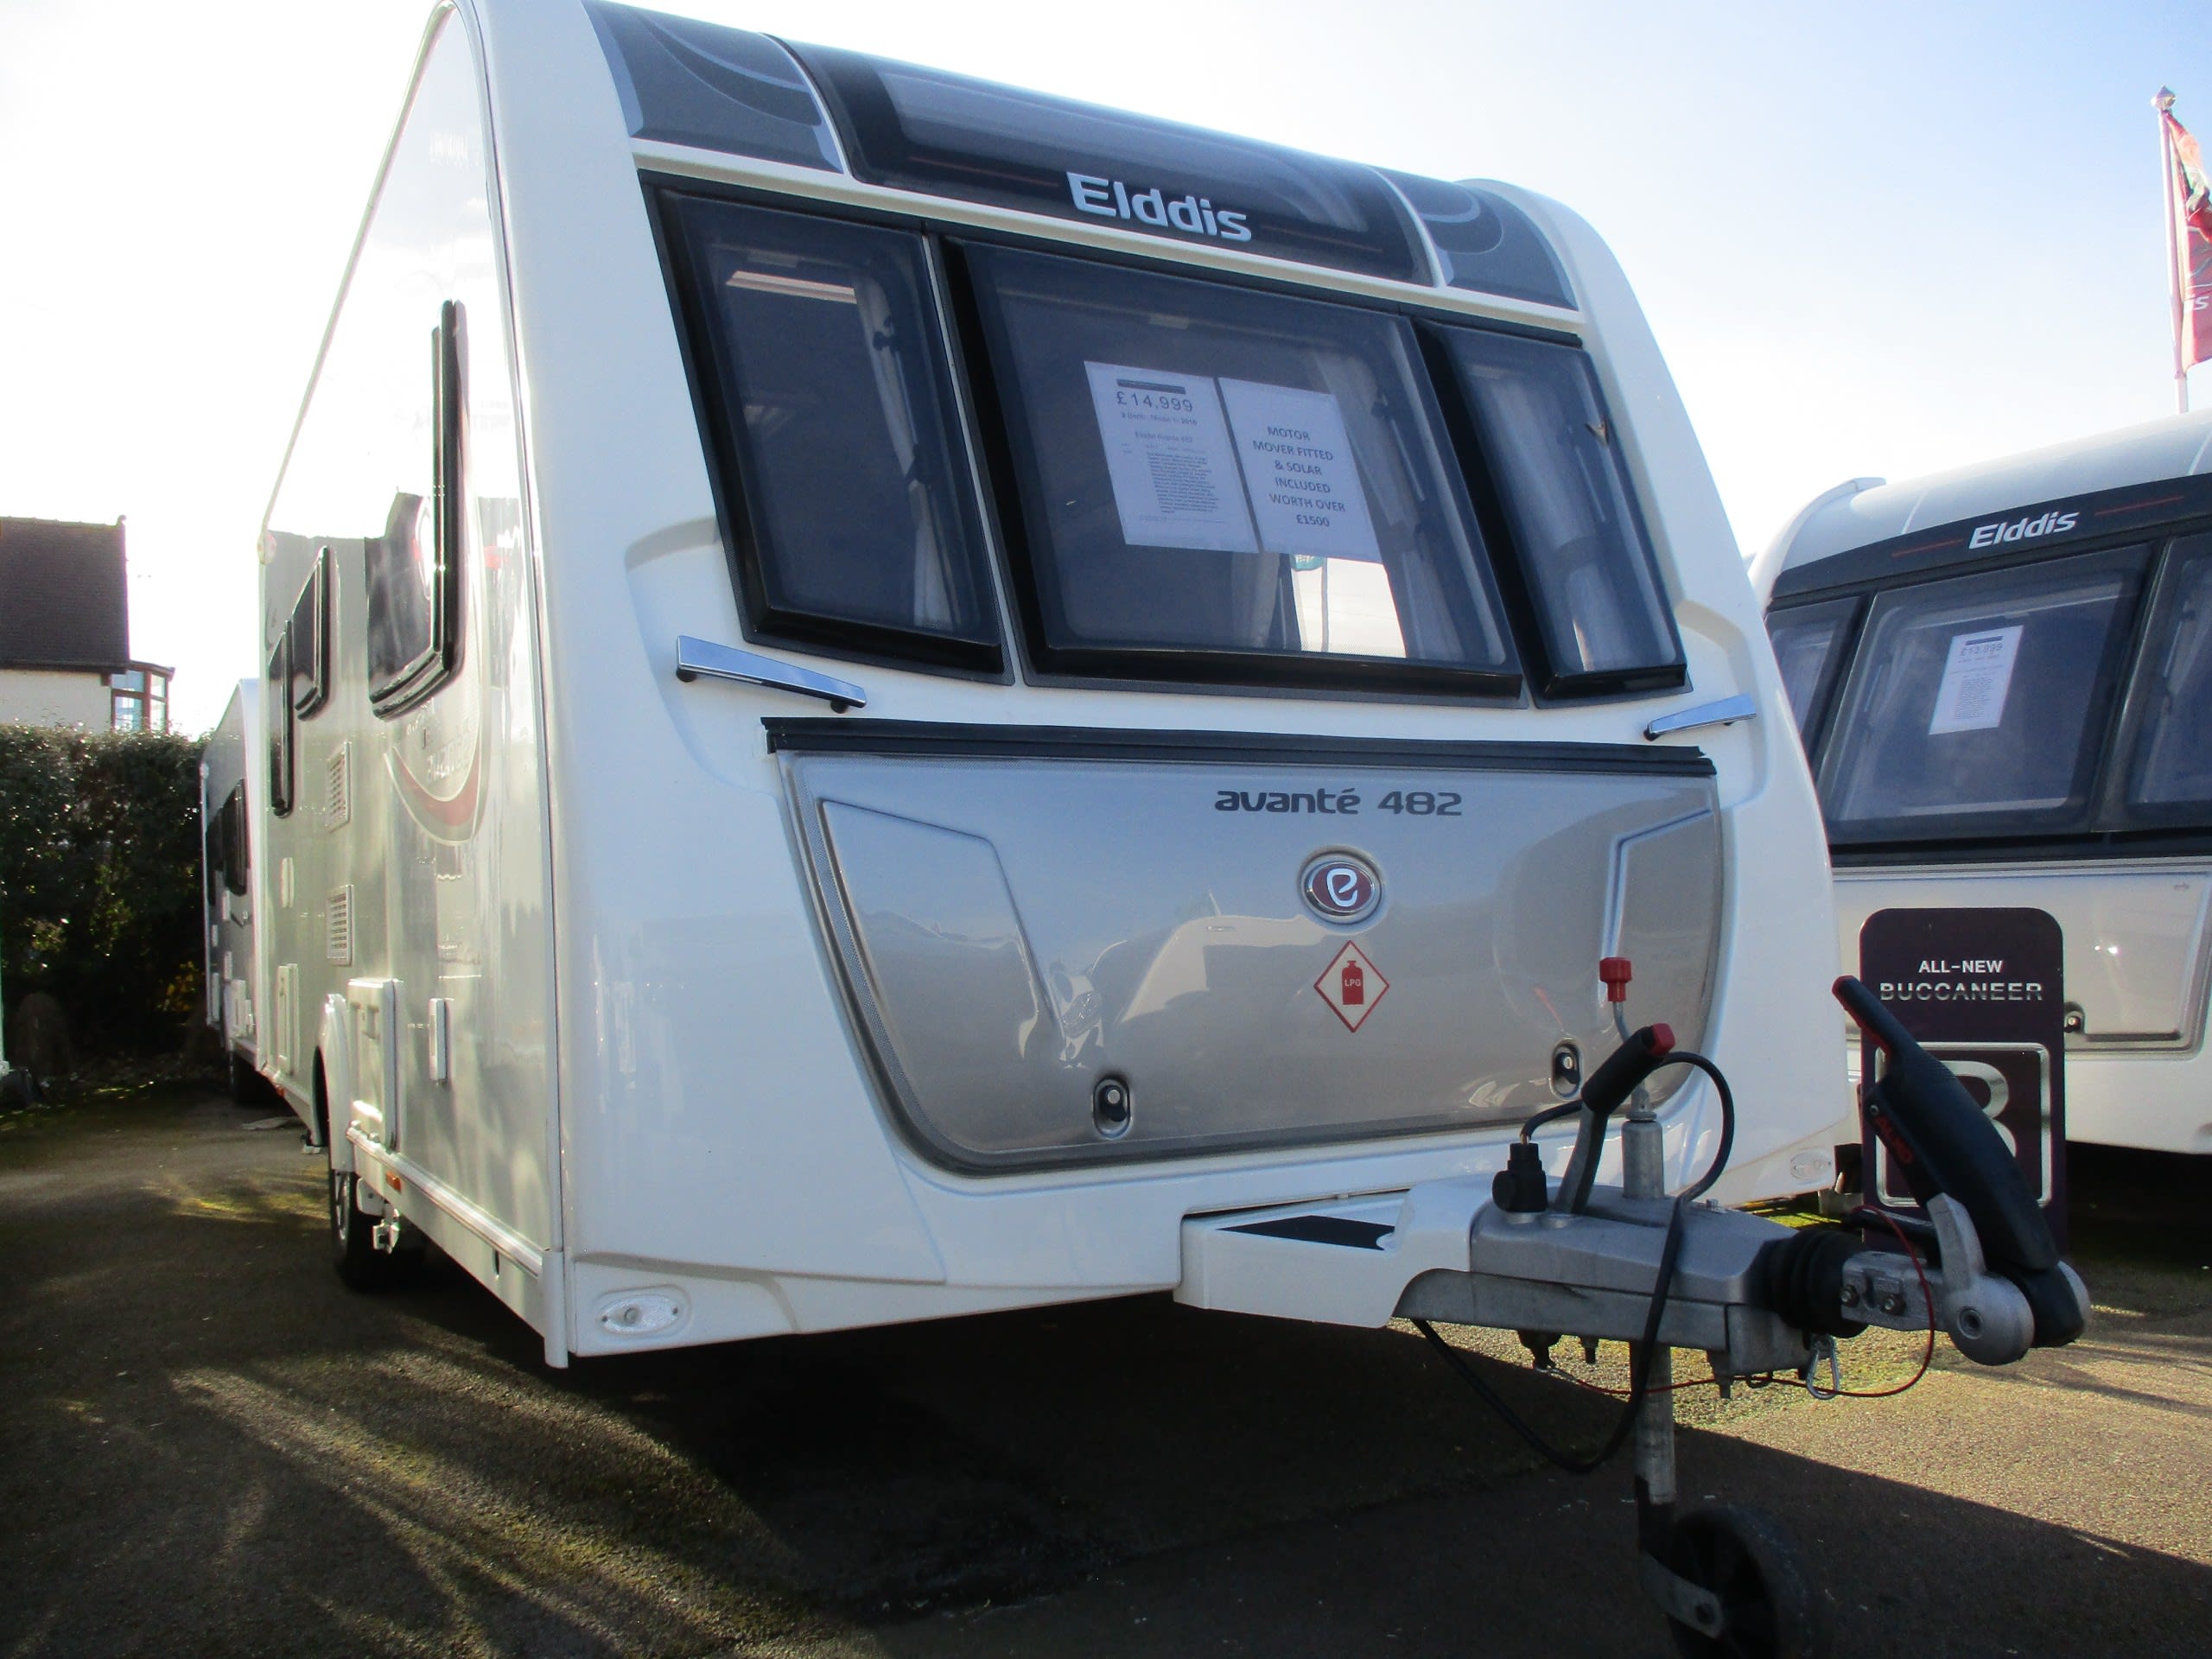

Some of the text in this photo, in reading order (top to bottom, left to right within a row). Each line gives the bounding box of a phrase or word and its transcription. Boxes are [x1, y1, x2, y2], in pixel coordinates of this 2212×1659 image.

[1066, 171, 1252, 243] Elddis
[1267, 426, 1311, 442] MOTOR
[1252, 440, 1334, 461] MOVER FITTED
[1274, 460, 1322, 476] & SOLAR
[1274, 477, 1332, 493] INCLUDED
[1268, 493, 1346, 512] WORTH OVER
[1296, 514, 1331, 527] £1500
[1968, 511, 2081, 550] Elddis
[1214, 787, 1463, 817] avanté 482
[1918, 960, 2004, 974] ALL-NEW
[1344, 978, 1362, 987] LPG
[1880, 982, 2044, 1001] BUCCANEER
